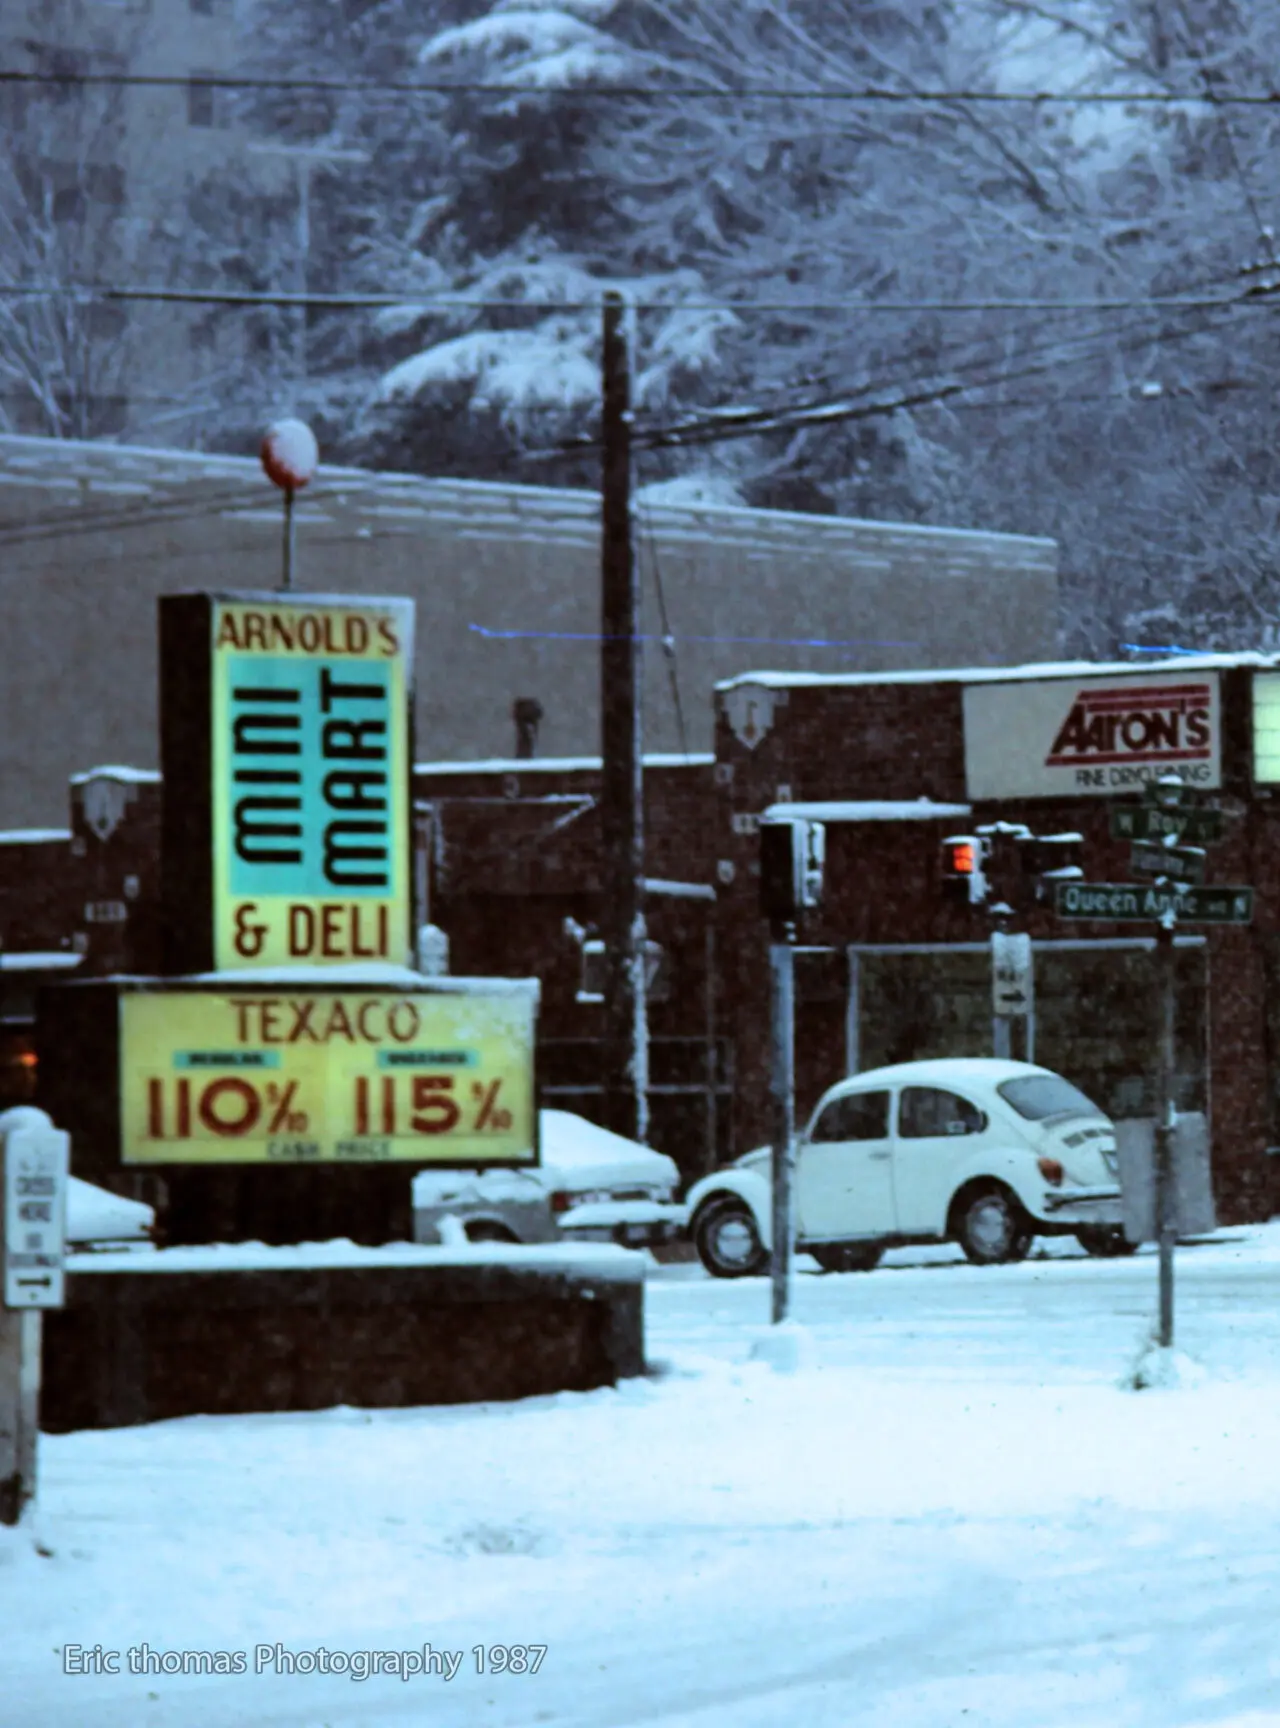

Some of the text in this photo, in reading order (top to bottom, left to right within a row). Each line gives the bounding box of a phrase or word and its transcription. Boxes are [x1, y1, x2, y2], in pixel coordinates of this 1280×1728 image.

[217, 612, 398, 657] ARNOLD'S
[233, 687, 302, 864] MINI
[319, 666, 388, 886] MART
[1065, 887, 1138, 912] Queen
[233, 902, 388, 958] & DELI
[230, 999, 421, 1044] TEXACO
